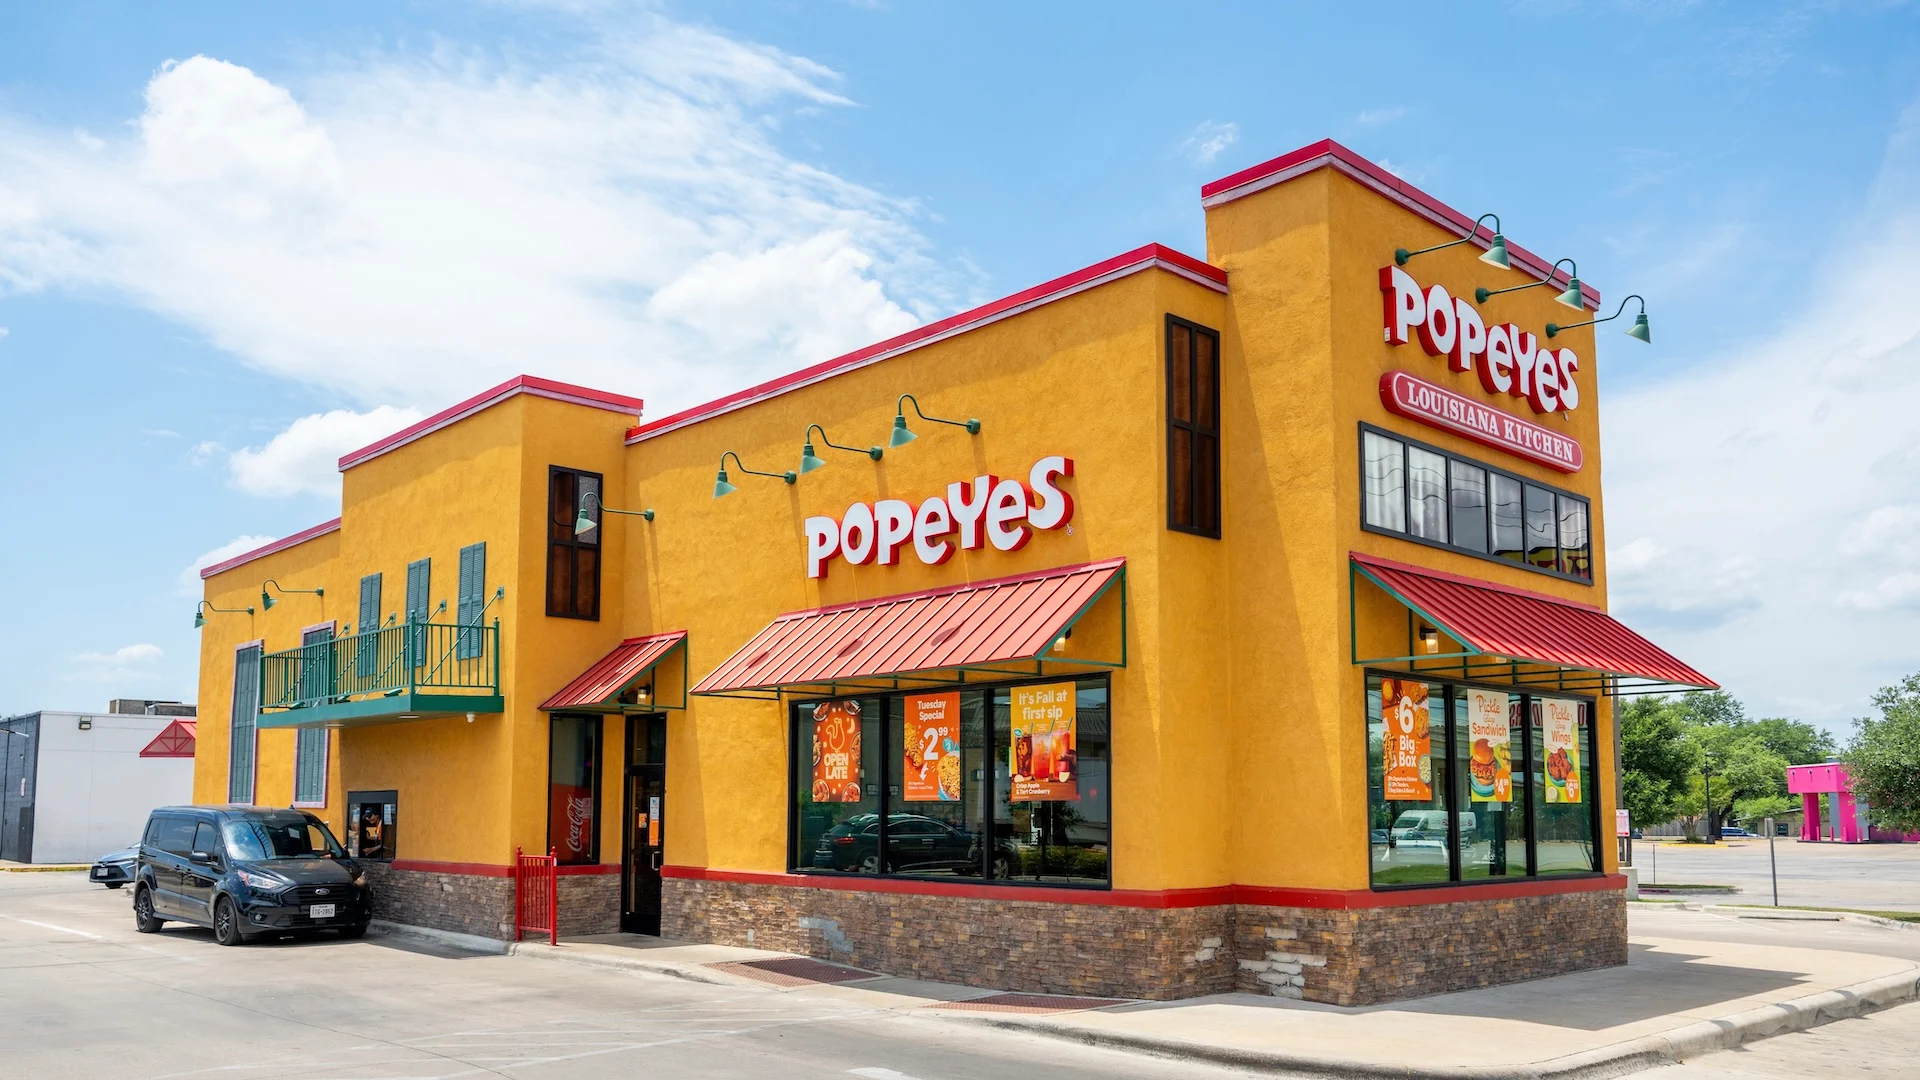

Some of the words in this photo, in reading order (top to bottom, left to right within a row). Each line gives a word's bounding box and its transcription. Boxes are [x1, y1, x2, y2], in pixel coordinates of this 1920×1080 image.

[1407, 381, 1500, 436] LOUISIANA
[1503, 419, 1573, 462] KITCHEN
[917, 699, 947, 710] Tuesday
[1019, 692, 1035, 705] It's
[1036, 690, 1054, 705] Fall
[1056, 689, 1068, 702] at
[1476, 694, 1500, 713] Pickle
[919, 710, 945, 722] Special
[1022, 707, 1046, 720] first
[1047, 705, 1063, 720] sip
[1549, 703, 1570, 720] Pickle
[1472, 722, 1507, 737] Sandwich
[1399, 735, 1415, 755] Big
[1551, 730, 1571, 746] Wings
[823, 753, 849, 766] OPEN
[1399, 751, 1417, 767] Box
[825, 766, 848, 780] LATE
